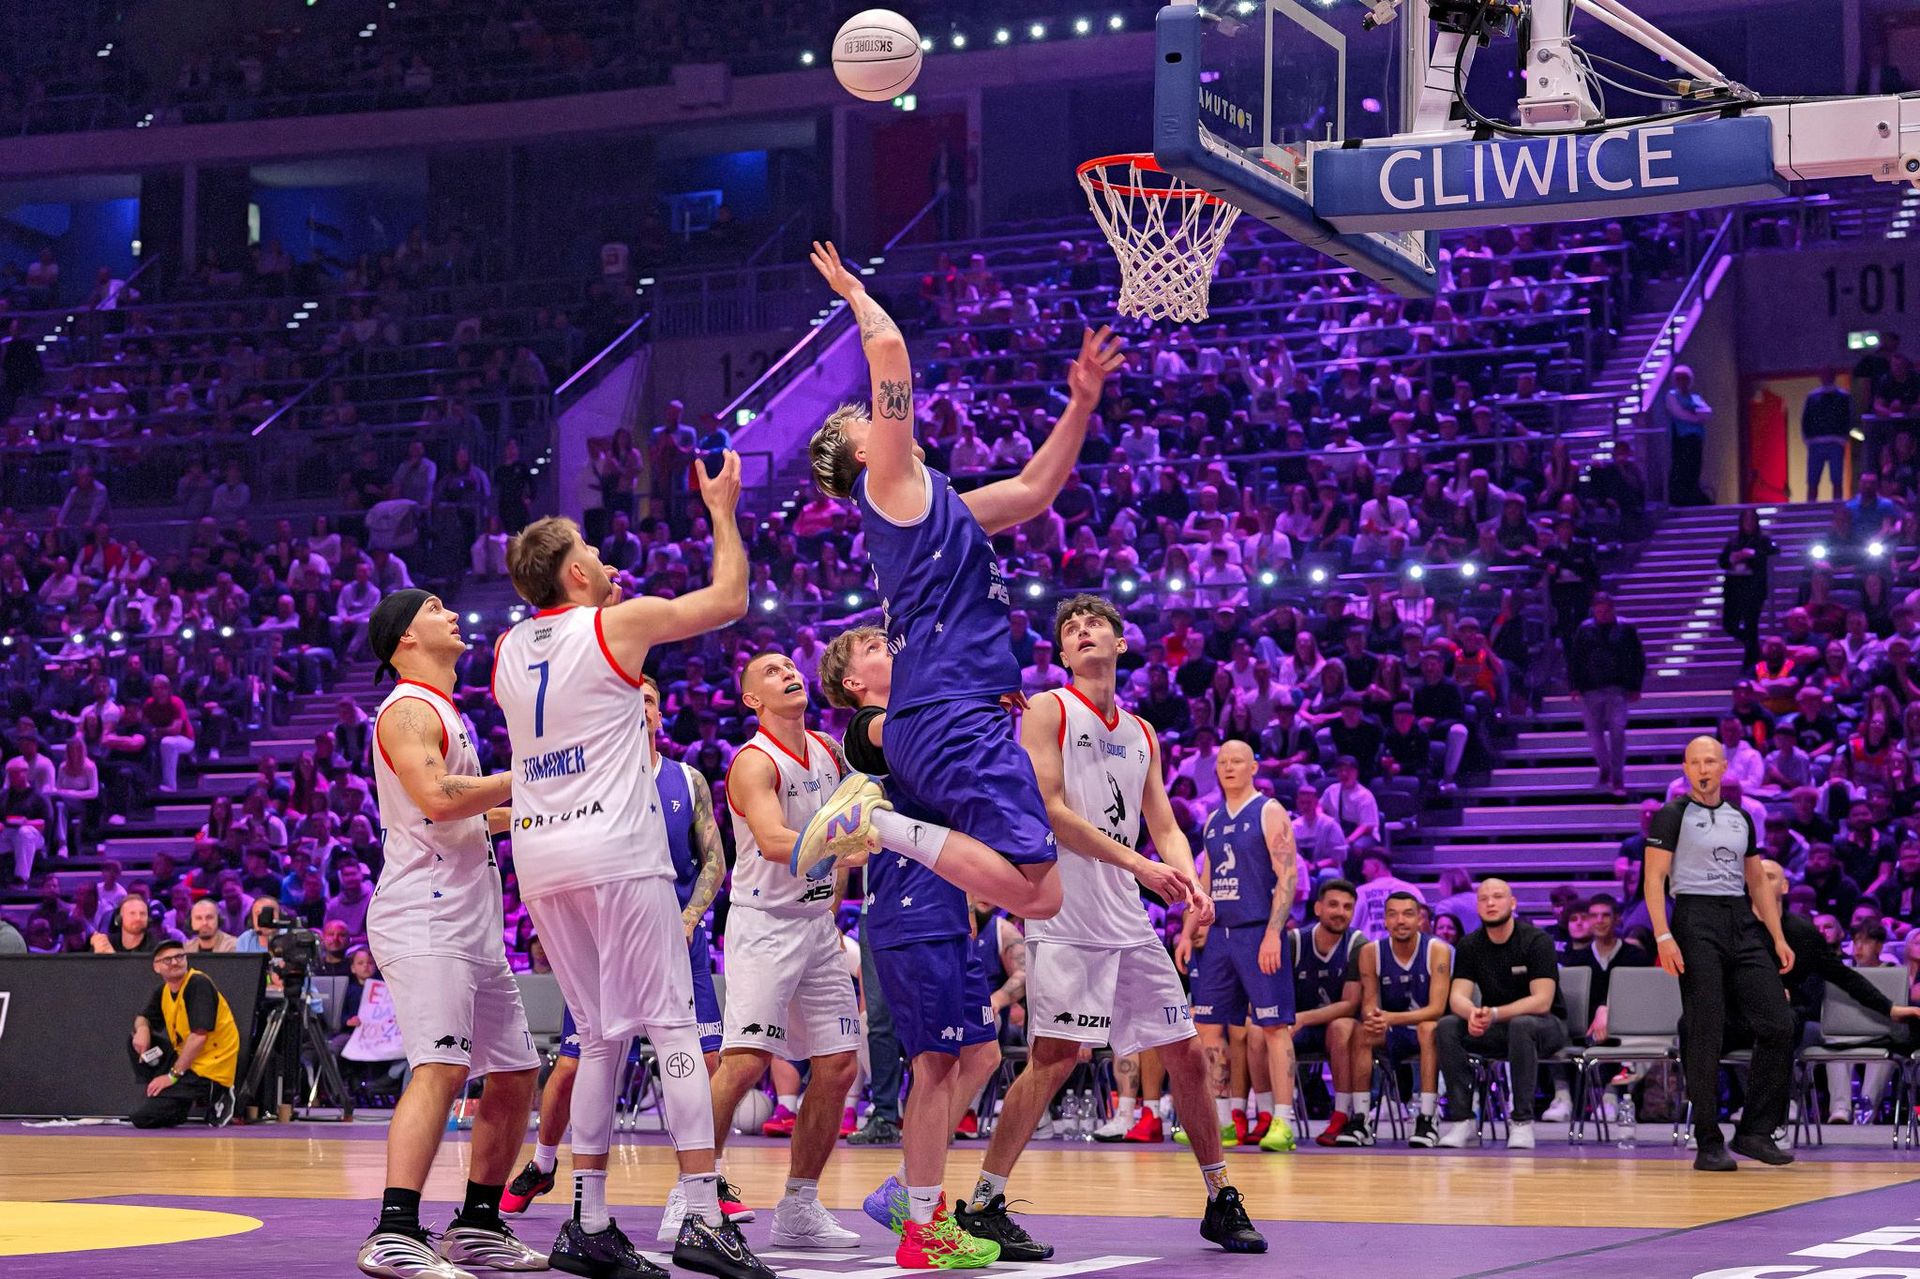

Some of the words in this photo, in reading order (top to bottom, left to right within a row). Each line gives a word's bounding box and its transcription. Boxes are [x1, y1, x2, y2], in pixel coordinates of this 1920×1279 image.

[1379, 126, 1679, 210] GLIWICE
[1822, 261, 1905, 316] 1-01
[527, 660, 550, 738] 7
[523, 745, 586, 784] TOMANEK
[513, 800, 605, 833] FORTUNA
